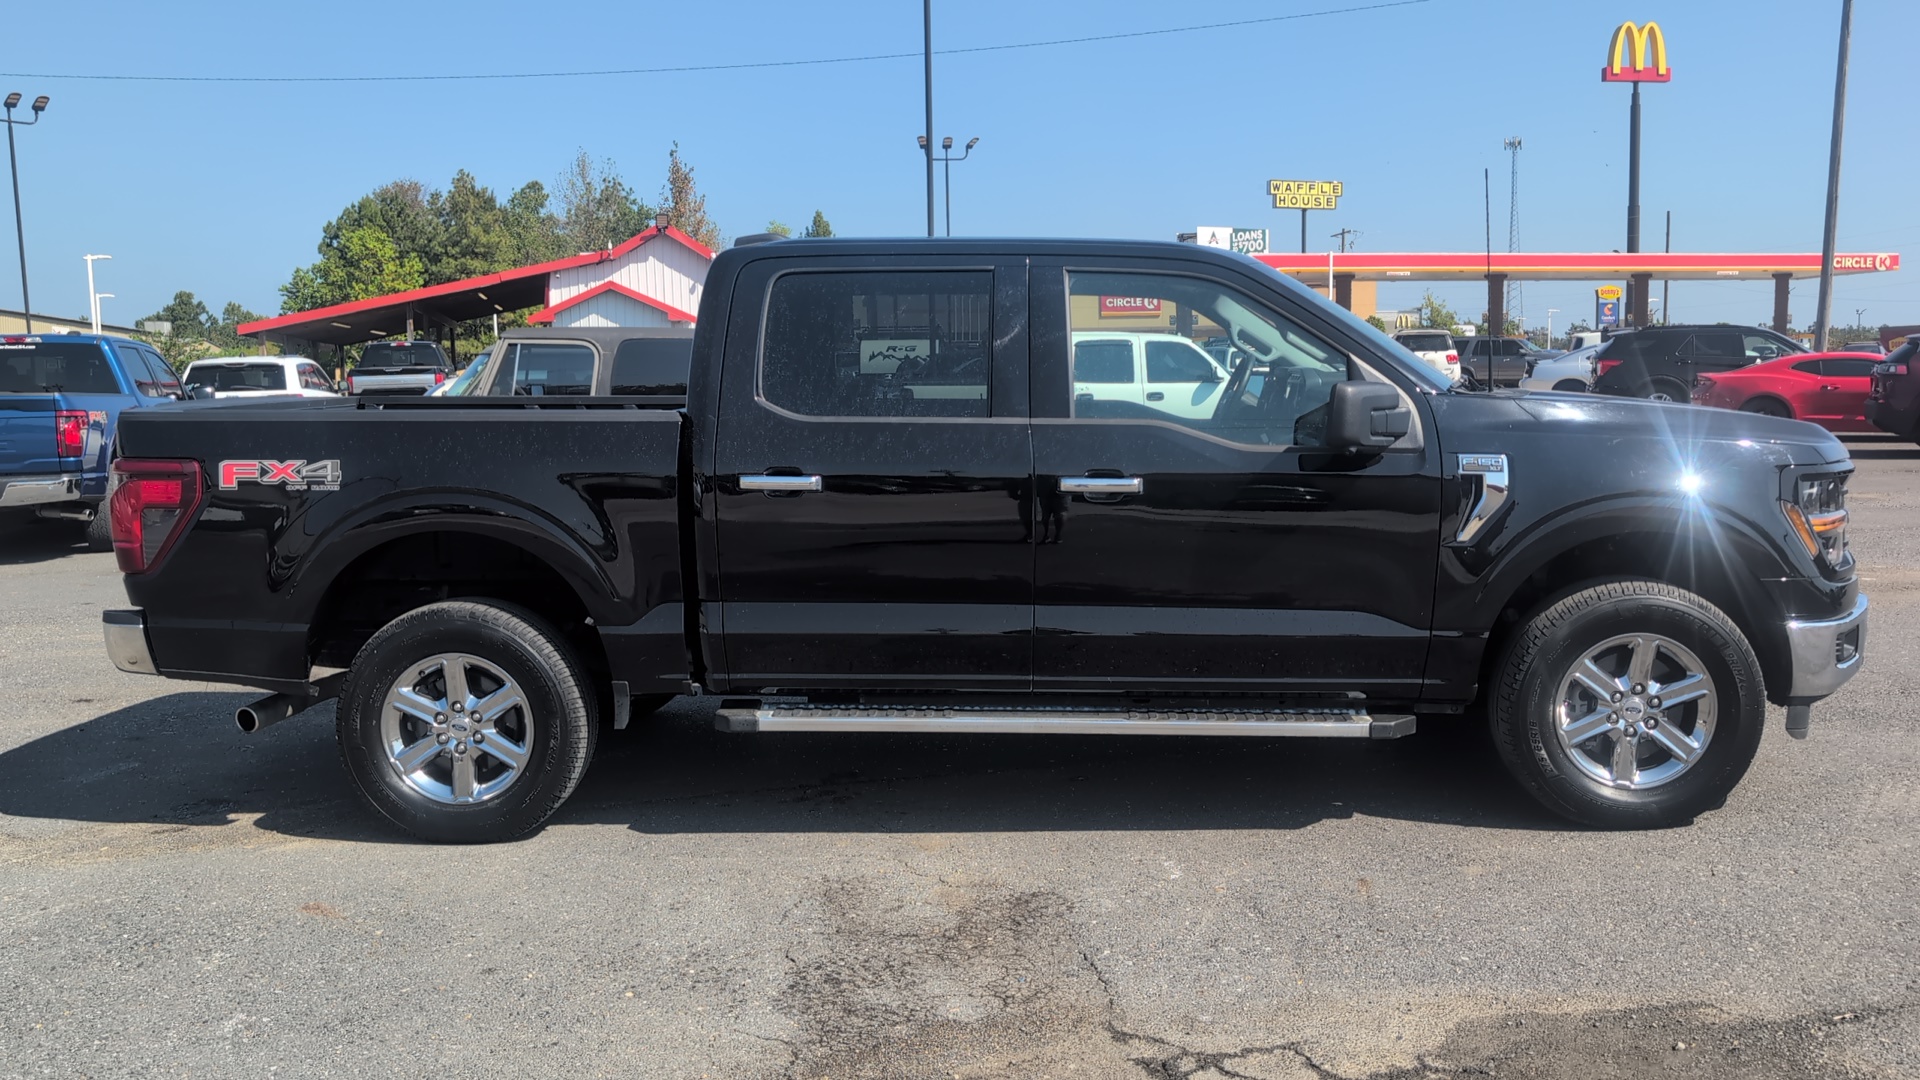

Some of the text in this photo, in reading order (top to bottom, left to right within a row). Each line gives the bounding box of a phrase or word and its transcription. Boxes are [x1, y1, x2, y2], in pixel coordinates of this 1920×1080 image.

[1272, 182, 1340, 194] WAFFLE
[1279, 195, 1334, 207] HOUSE
[1232, 230, 1263, 242] LOANS
[1833, 255, 1890, 271] CIRCLE K
[1105, 297, 1158, 309] CIRCLE K
[219, 459, 342, 491] FX4
